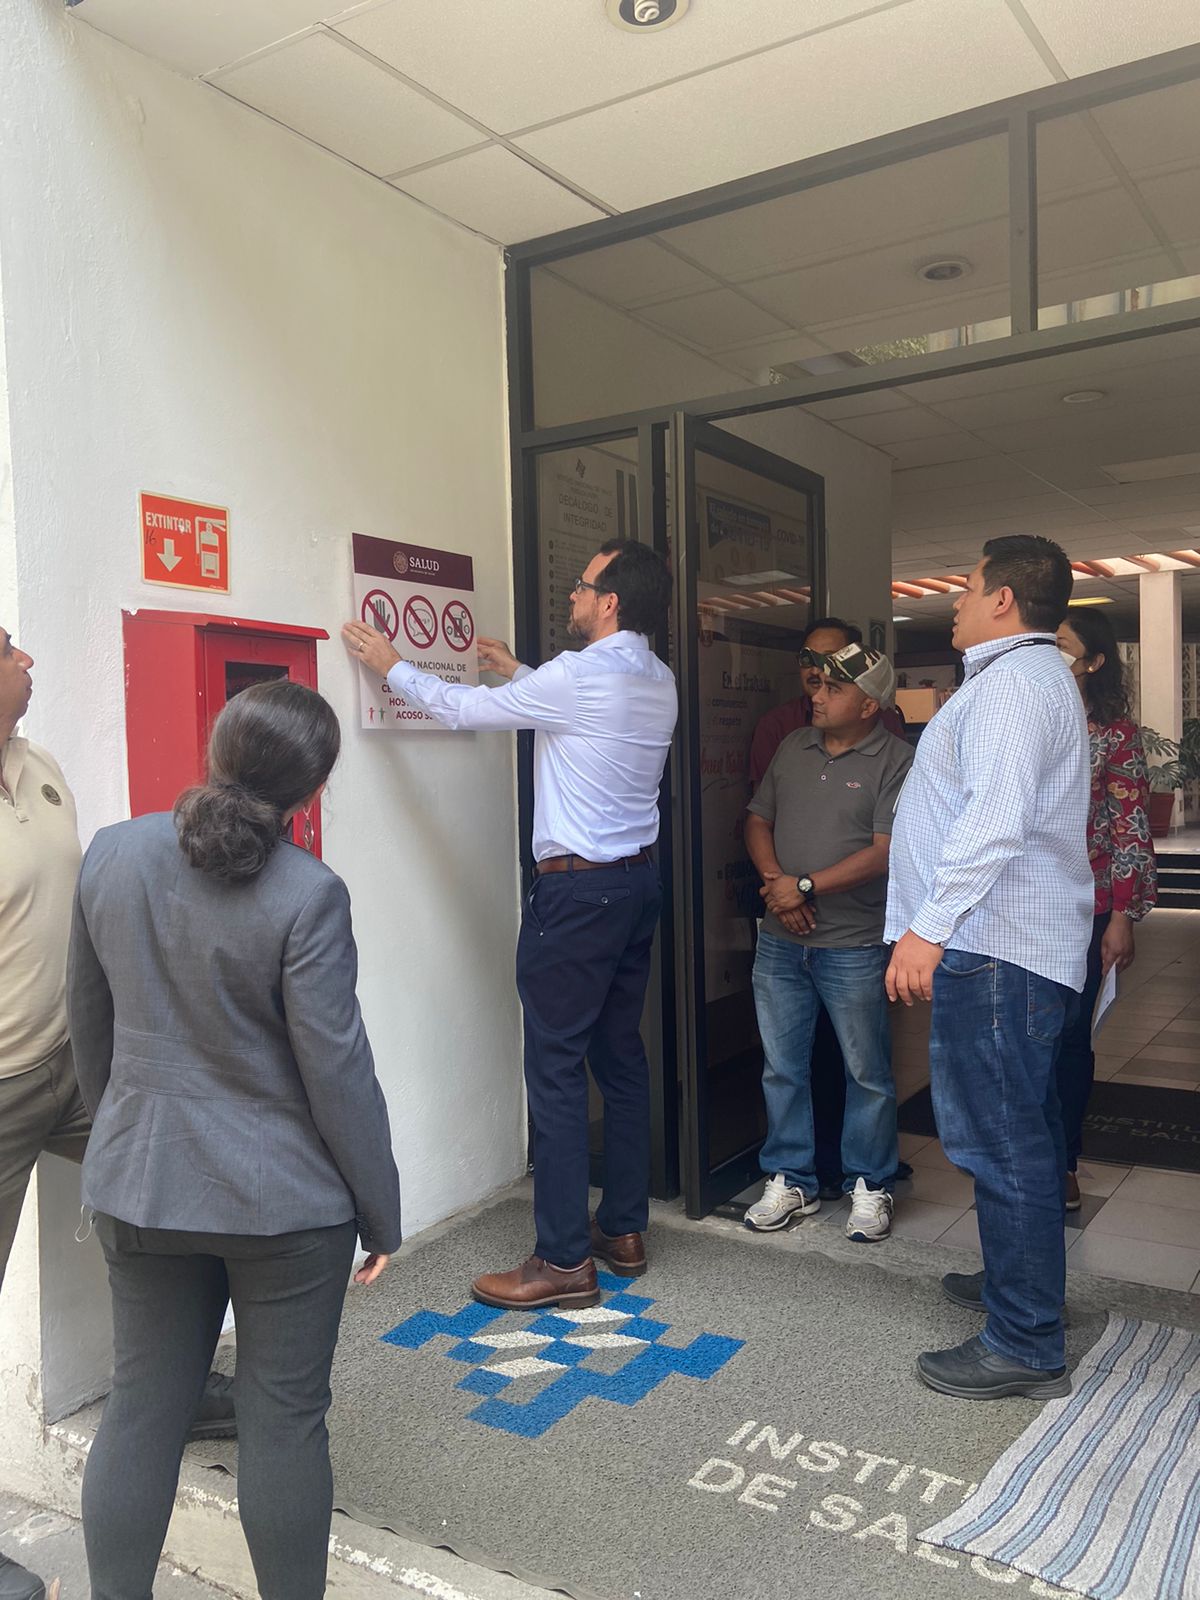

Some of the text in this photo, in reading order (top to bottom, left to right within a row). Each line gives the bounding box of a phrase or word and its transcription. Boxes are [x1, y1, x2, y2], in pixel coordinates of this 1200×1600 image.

[145, 511, 192, 534] EXTINTOR
[563, 511, 607, 532] INTEGRIDAD
[409, 556, 440, 572] SALUD
[417, 661, 455, 671] NACIONAL
[457, 663, 467, 672] DE
[445, 675, 461, 684] CON
[395, 711, 424, 720] ACOSO
[687, 1457, 798, 1513] DE
